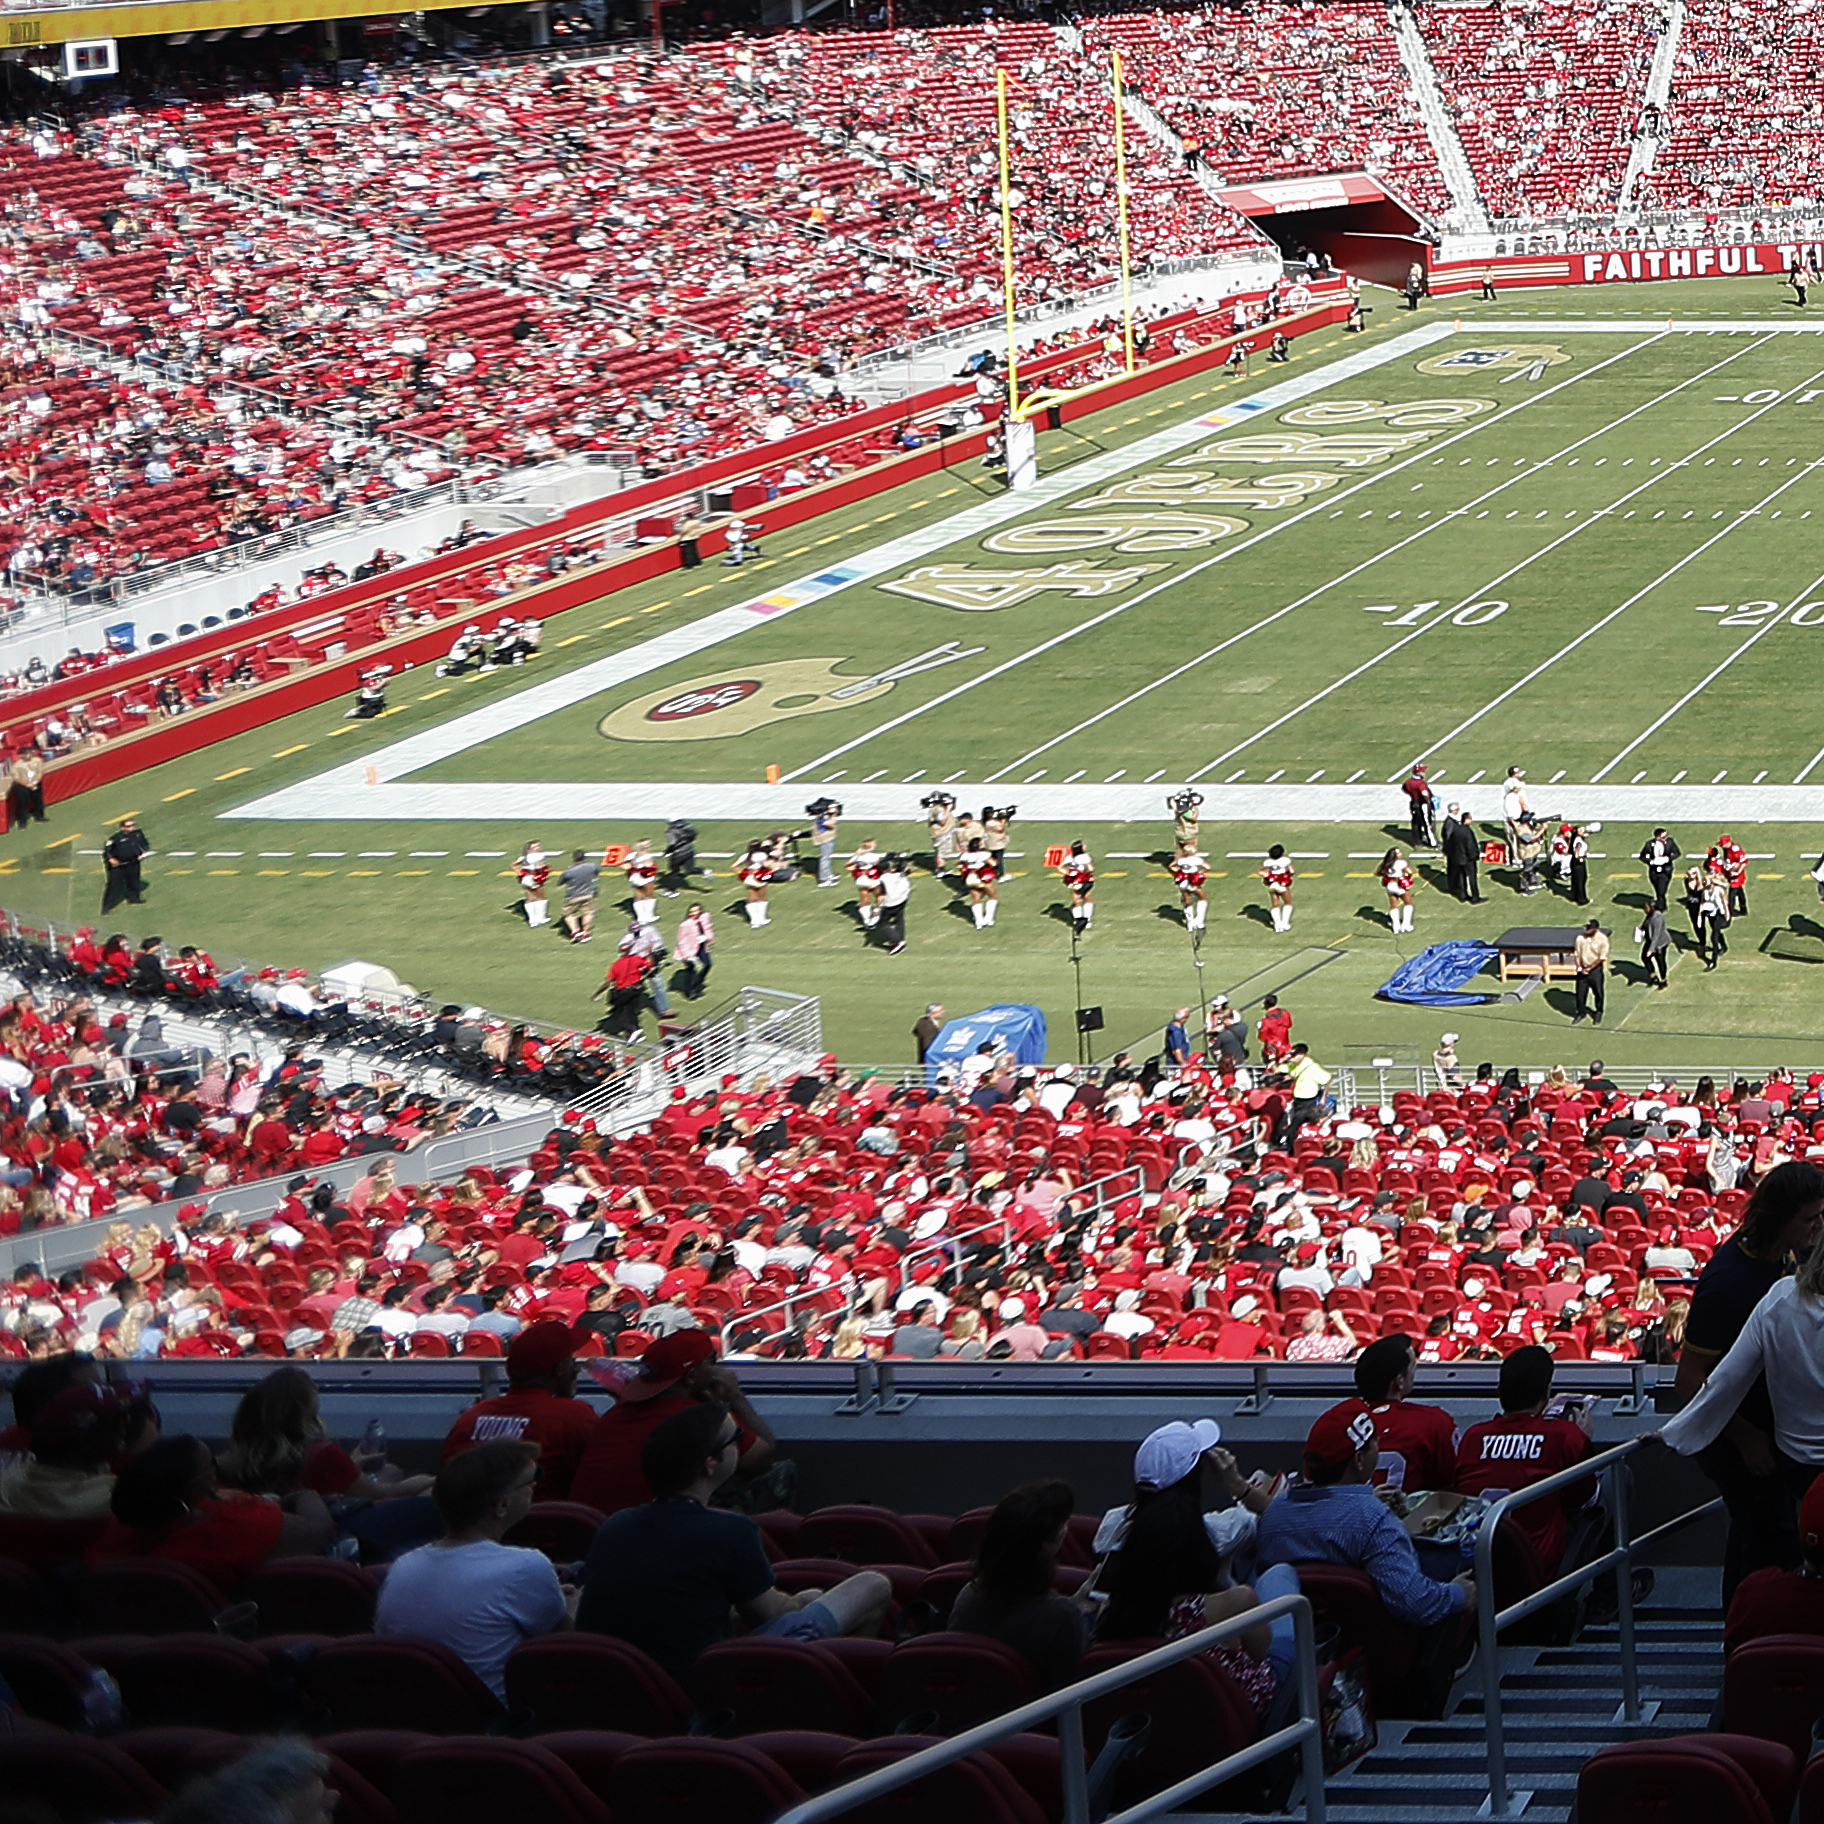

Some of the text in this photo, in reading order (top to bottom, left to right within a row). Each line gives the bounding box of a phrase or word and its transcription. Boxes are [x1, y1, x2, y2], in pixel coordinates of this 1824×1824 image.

[1583, 246, 1765, 281] FAITHFUL
[875, 398, 1498, 612] 49ERS
[1385, 600, 1510, 628] 10
[469, 1414, 530, 1442] YOUNG
[1347, 1412, 1375, 1451] 16
[1480, 1433, 1545, 1460] YOUNG
